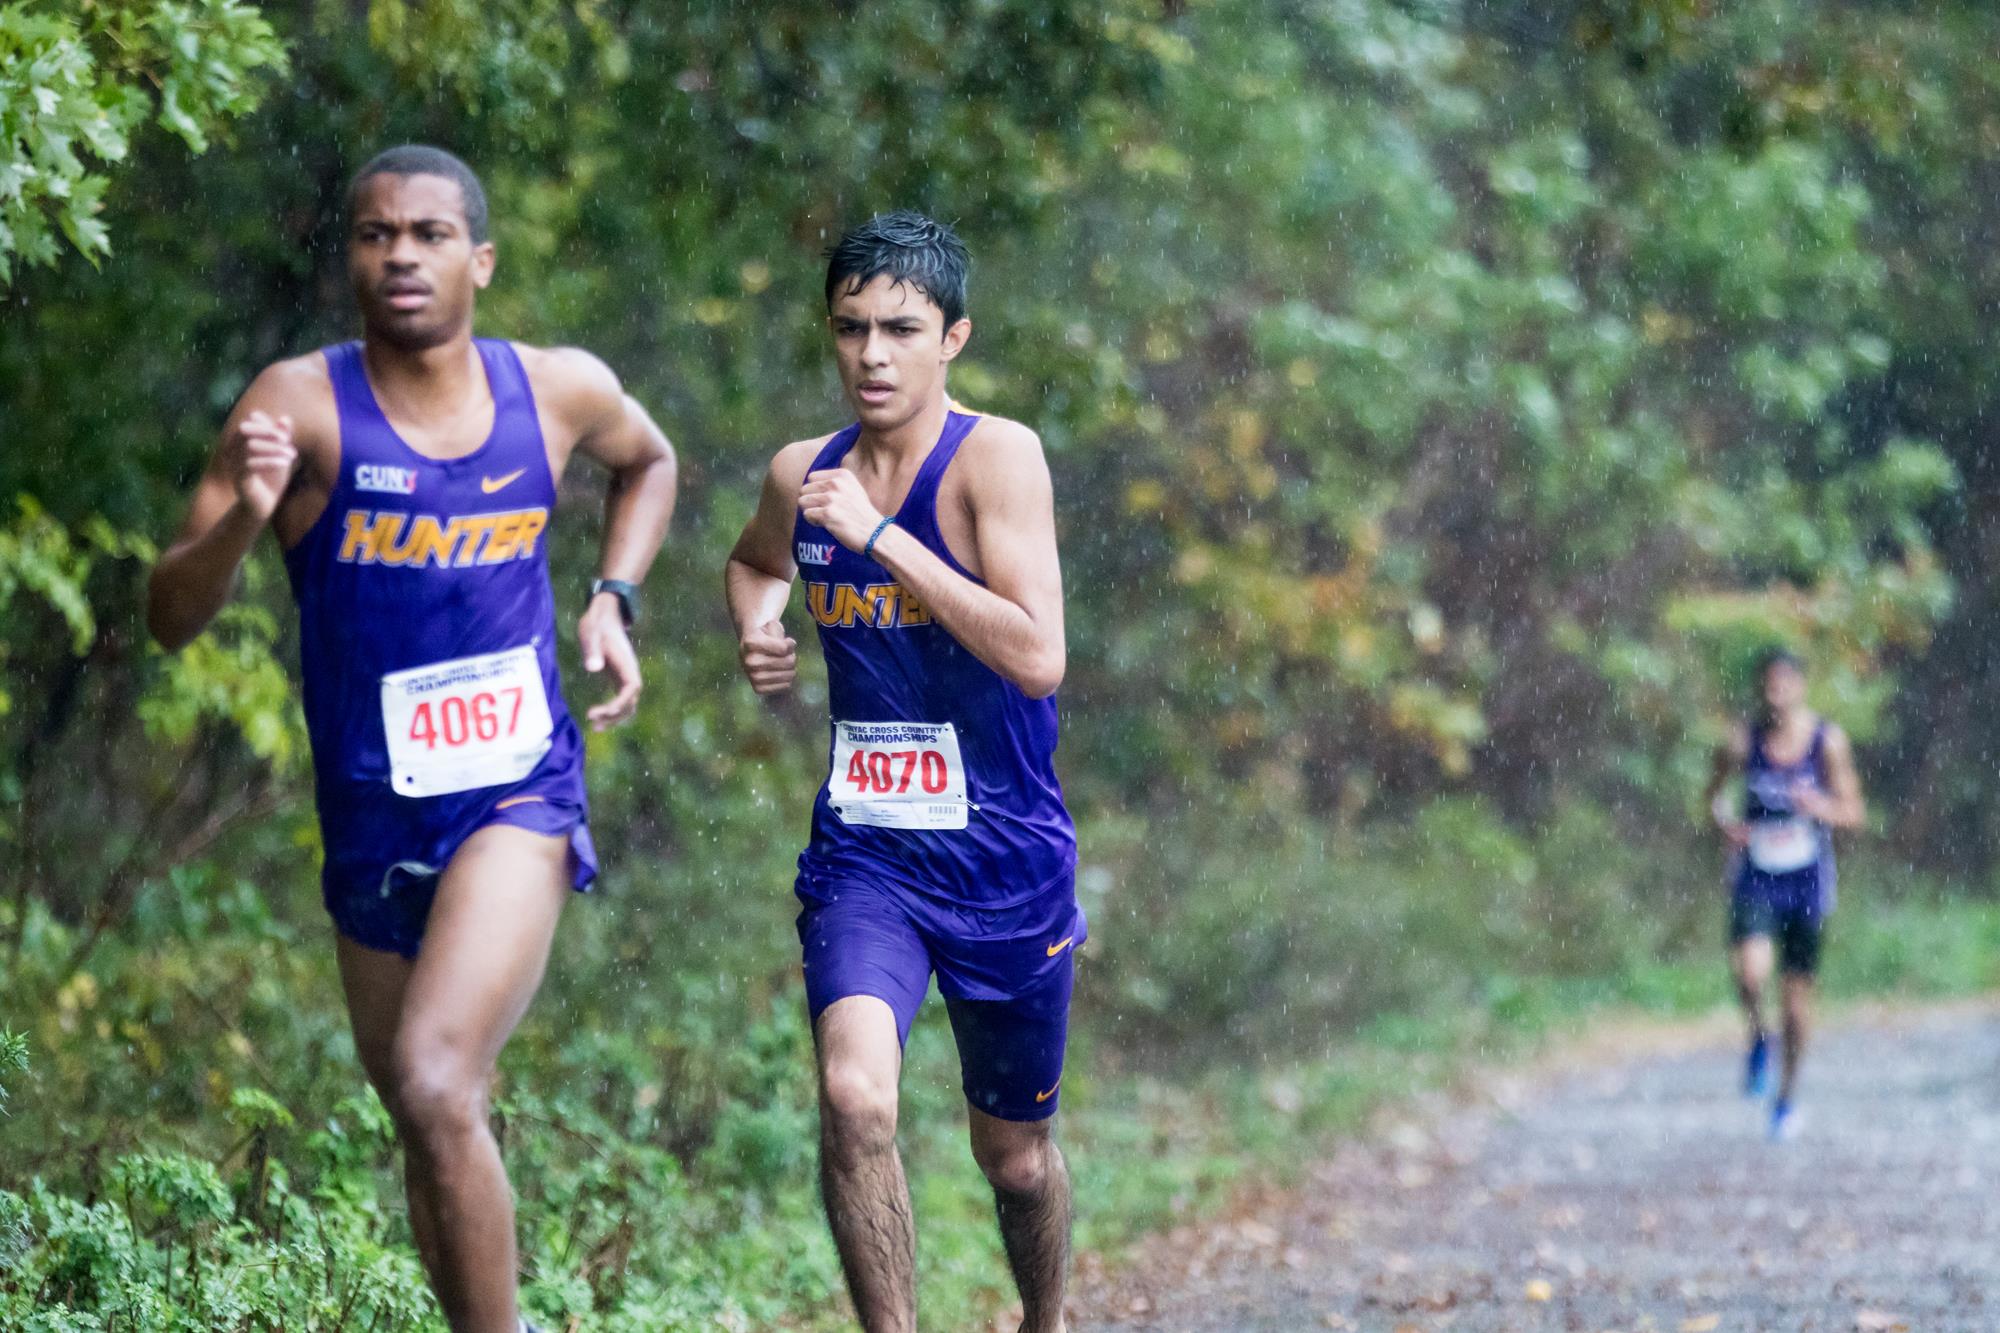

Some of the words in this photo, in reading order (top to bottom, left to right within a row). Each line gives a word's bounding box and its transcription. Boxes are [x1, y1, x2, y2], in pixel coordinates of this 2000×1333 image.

[337, 507, 547, 569] HUNTER
[808, 582, 930, 628] UNTE
[409, 686, 523, 749] 4067
[848, 732, 937, 743] CHAMPIONSHIPS
[870, 726, 898, 734] CROSS
[902, 726, 942, 734] COUNTRY
[846, 750, 947, 794] 4070
